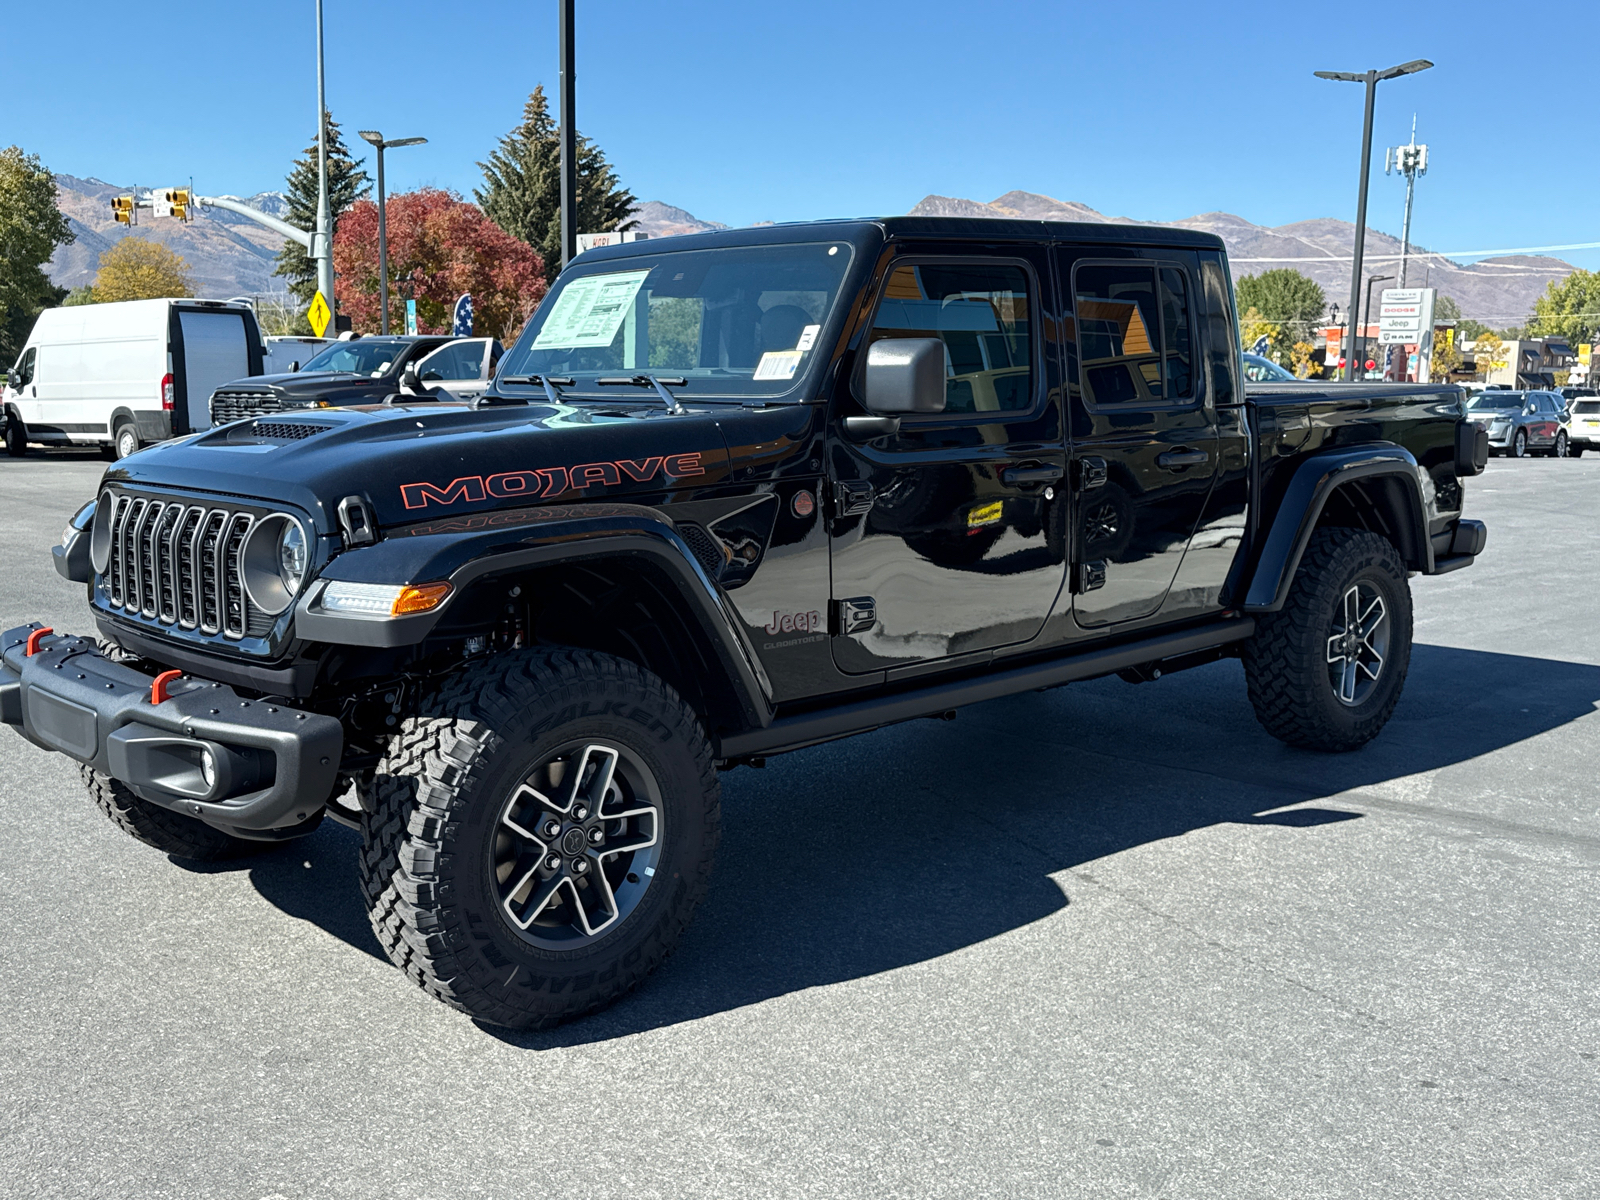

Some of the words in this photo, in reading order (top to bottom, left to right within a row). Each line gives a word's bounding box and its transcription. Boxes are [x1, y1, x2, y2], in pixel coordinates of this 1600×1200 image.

[1388, 319, 1409, 328] Jeep
[400, 452, 705, 510] MOJAVE
[764, 610, 821, 635] Jeep
[763, 636, 815, 650] GLADIATOR
